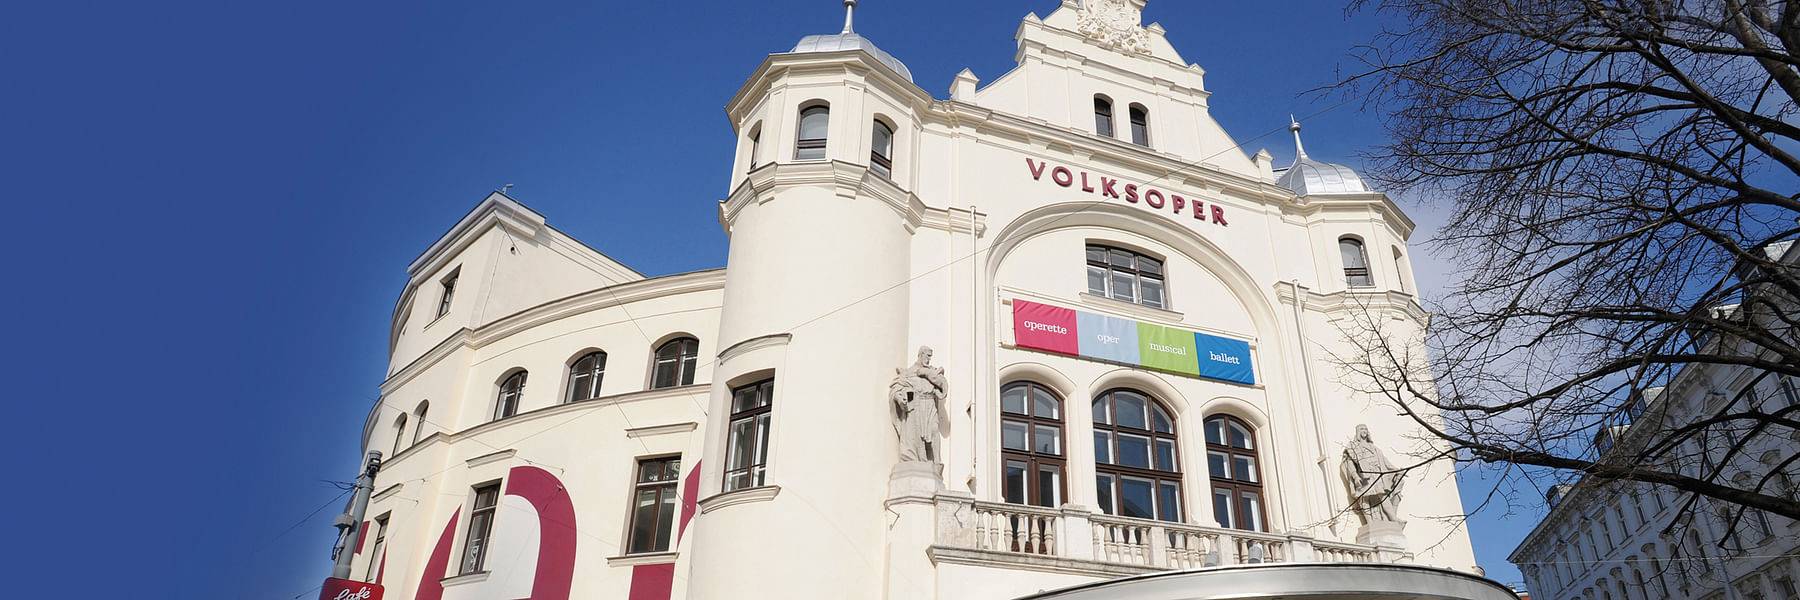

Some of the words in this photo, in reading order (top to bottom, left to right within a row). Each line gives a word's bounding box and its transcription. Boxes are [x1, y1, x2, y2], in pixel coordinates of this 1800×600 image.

[1026, 158, 1228, 226] VOLKSOPER
[1024, 319, 1067, 335] operette
[1097, 333, 1120, 345] oper
[1150, 342, 1186, 355] musical
[1210, 351, 1240, 364] ballett
